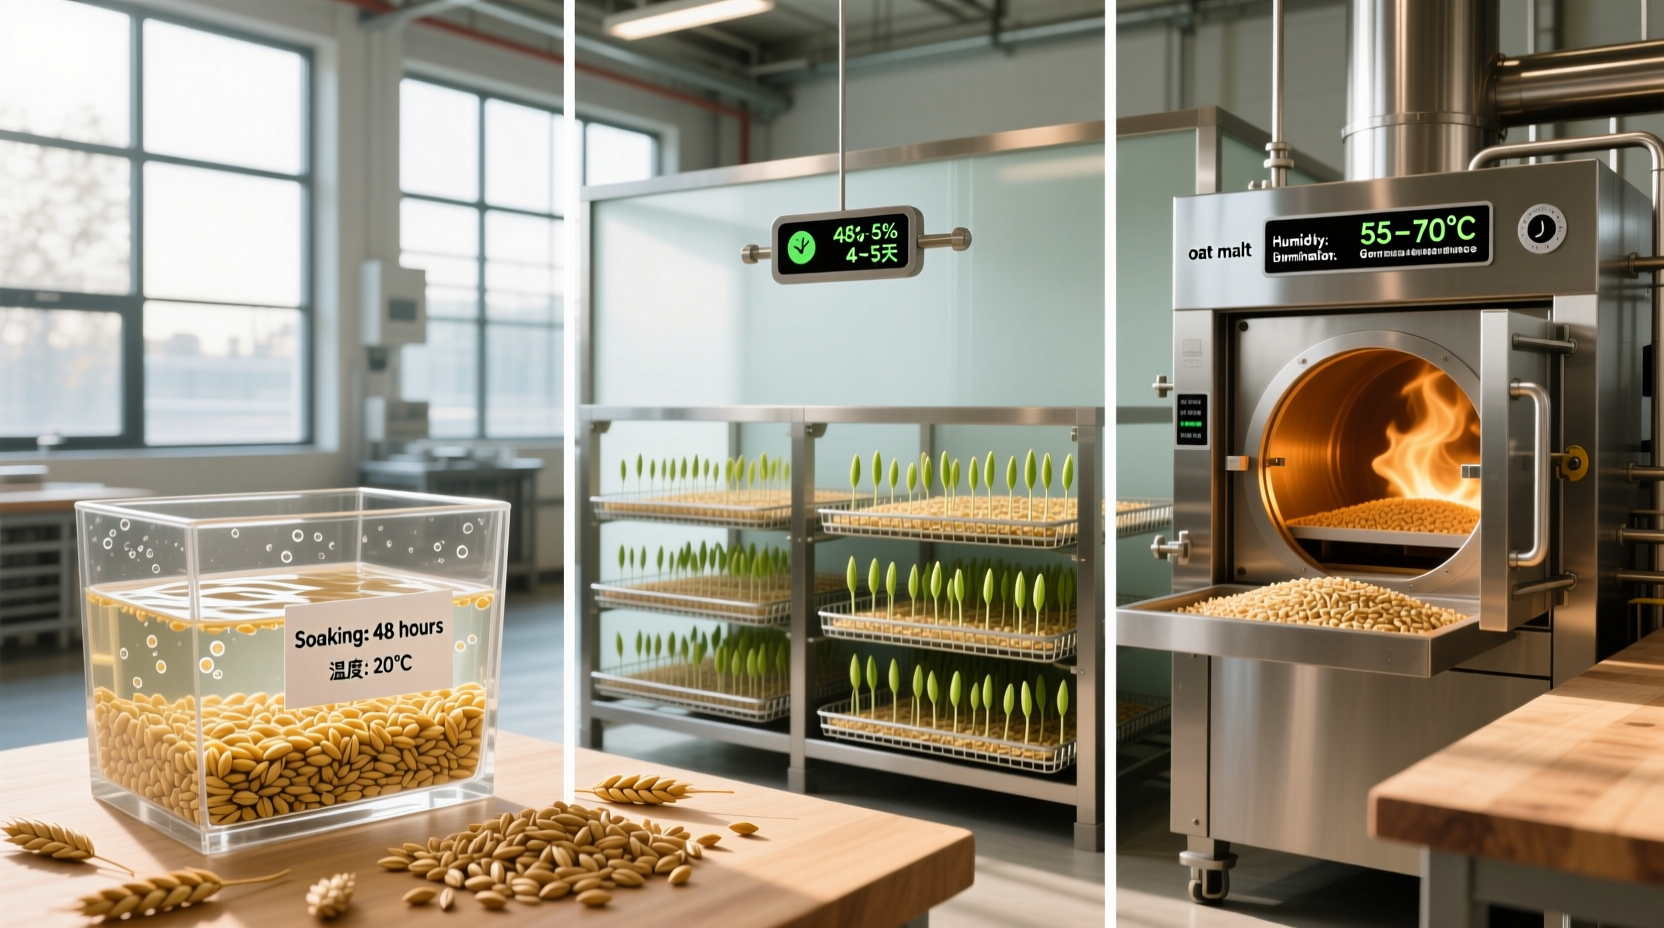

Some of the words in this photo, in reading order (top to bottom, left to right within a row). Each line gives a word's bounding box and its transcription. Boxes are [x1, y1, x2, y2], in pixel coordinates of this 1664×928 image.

[1188, 245, 1213, 260] oat
[1217, 241, 1252, 258] malt
[294, 626, 370, 649] Soaking:
[373, 622, 395, 640] 48
[399, 620, 444, 638] hours
